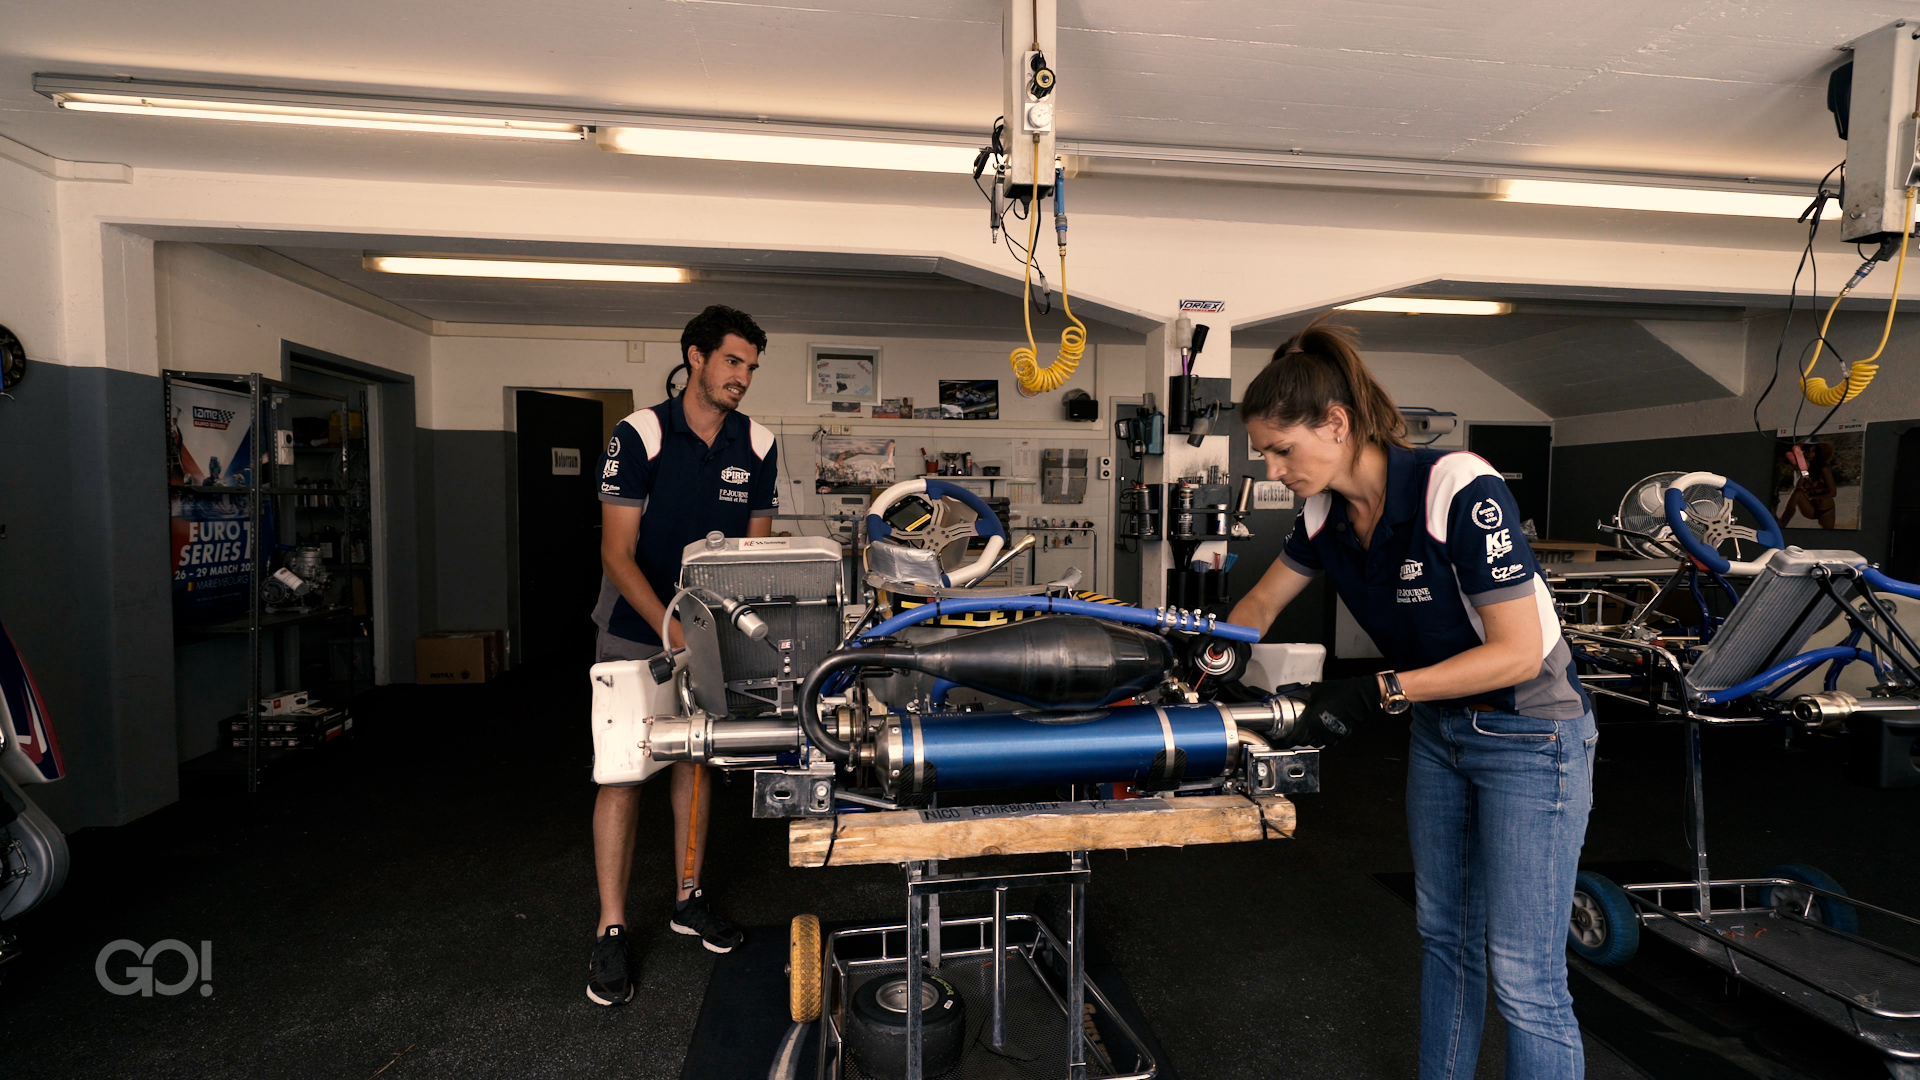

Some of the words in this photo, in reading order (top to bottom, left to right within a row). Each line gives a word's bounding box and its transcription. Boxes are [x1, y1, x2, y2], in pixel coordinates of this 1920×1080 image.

[1179, 300, 1220, 309] VORTEX
[604, 459, 620, 472] KE
[720, 471, 751, 480] SPIRIT
[1257, 484, 1290, 502] Werkstatt
[1479, 506, 1496, 515] BORN
[189, 521, 241, 542] EURO
[1486, 528, 1512, 551] KE
[178, 541, 242, 567] SERIES
[1534, 551, 1575, 563] ame
[173, 570, 187, 580] 26
[195, 566, 208, 578] 29
[209, 564, 239, 576] MARCH
[693, 616, 709, 630] KE
[780, 641, 792, 649] KE
[925, 808, 961, 820] NICO
